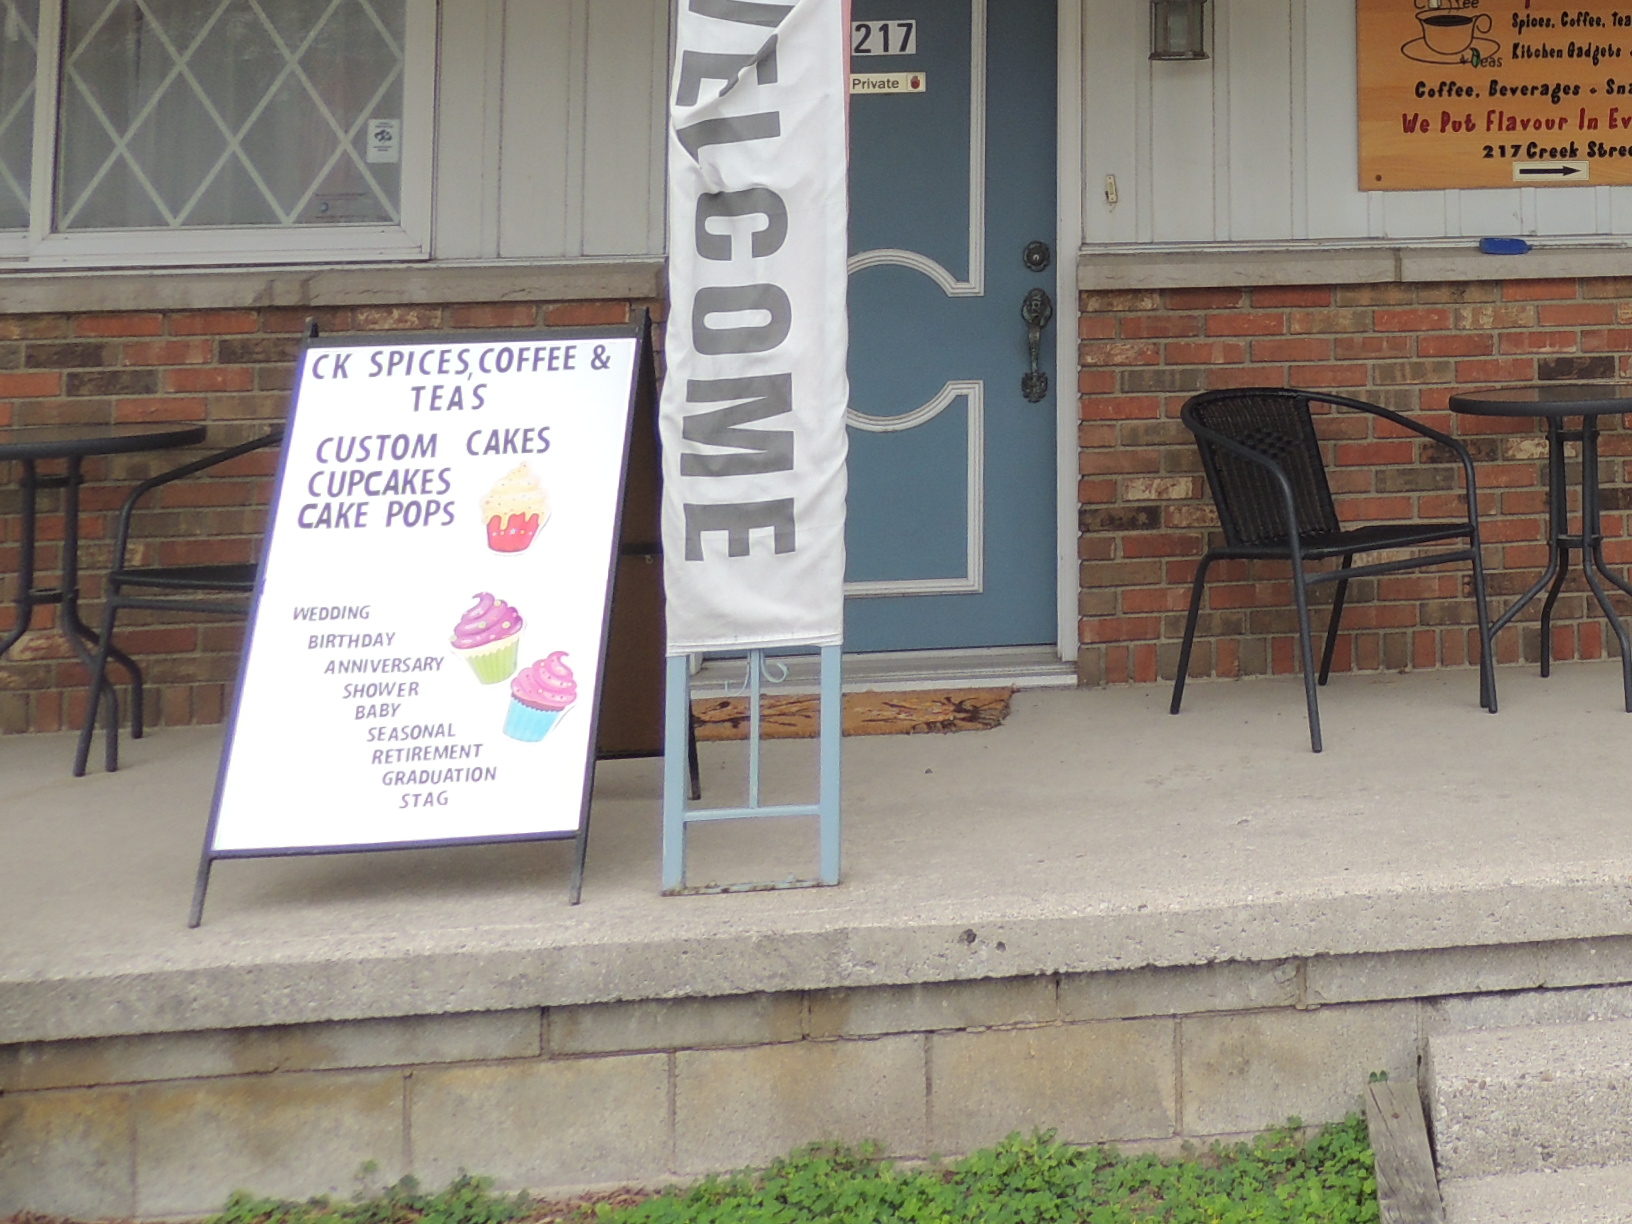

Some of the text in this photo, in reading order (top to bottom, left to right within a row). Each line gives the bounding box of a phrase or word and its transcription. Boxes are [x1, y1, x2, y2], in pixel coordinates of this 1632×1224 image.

[853, 23, 914, 54] 217
[1511, 41, 1563, 60] Kitchen
[1566, 41, 1623, 66] Gadgets
[852, 77, 900, 90] Private
[1414, 80, 1481, 99] Coffee,
[1488, 79, 1581, 105] Beverages
[1401, 112, 1431, 135] We
[1439, 110, 1477, 133] Put
[1486, 109, 1569, 133] Flavour
[1578, 108, 1599, 131] In
[1482, 144, 1522, 159] 217
[1525, 141, 1580, 159] Creek
[311, 353, 353, 379] CK
[589, 344, 612, 371] &
[410, 382, 488, 412] TEAS
[315, 426, 552, 464] CUSTOM CAKES
[307, 466, 453, 498] CUPCAKES
[297, 498, 456, 530] CAKE POPS
[292, 604, 371, 622] WEDDING
[307, 631, 396, 650] BIRTHDAY
[324, 655, 445, 675] ANNIVERSARY
[342, 681, 420, 700] SHOWER
[354, 702, 401, 720] BABY
[366, 722, 456, 743] SEASONAL
[371, 743, 483, 765] RETIREMENT
[381, 766, 498, 787] GRADUATION
[399, 790, 449, 810] STAG
